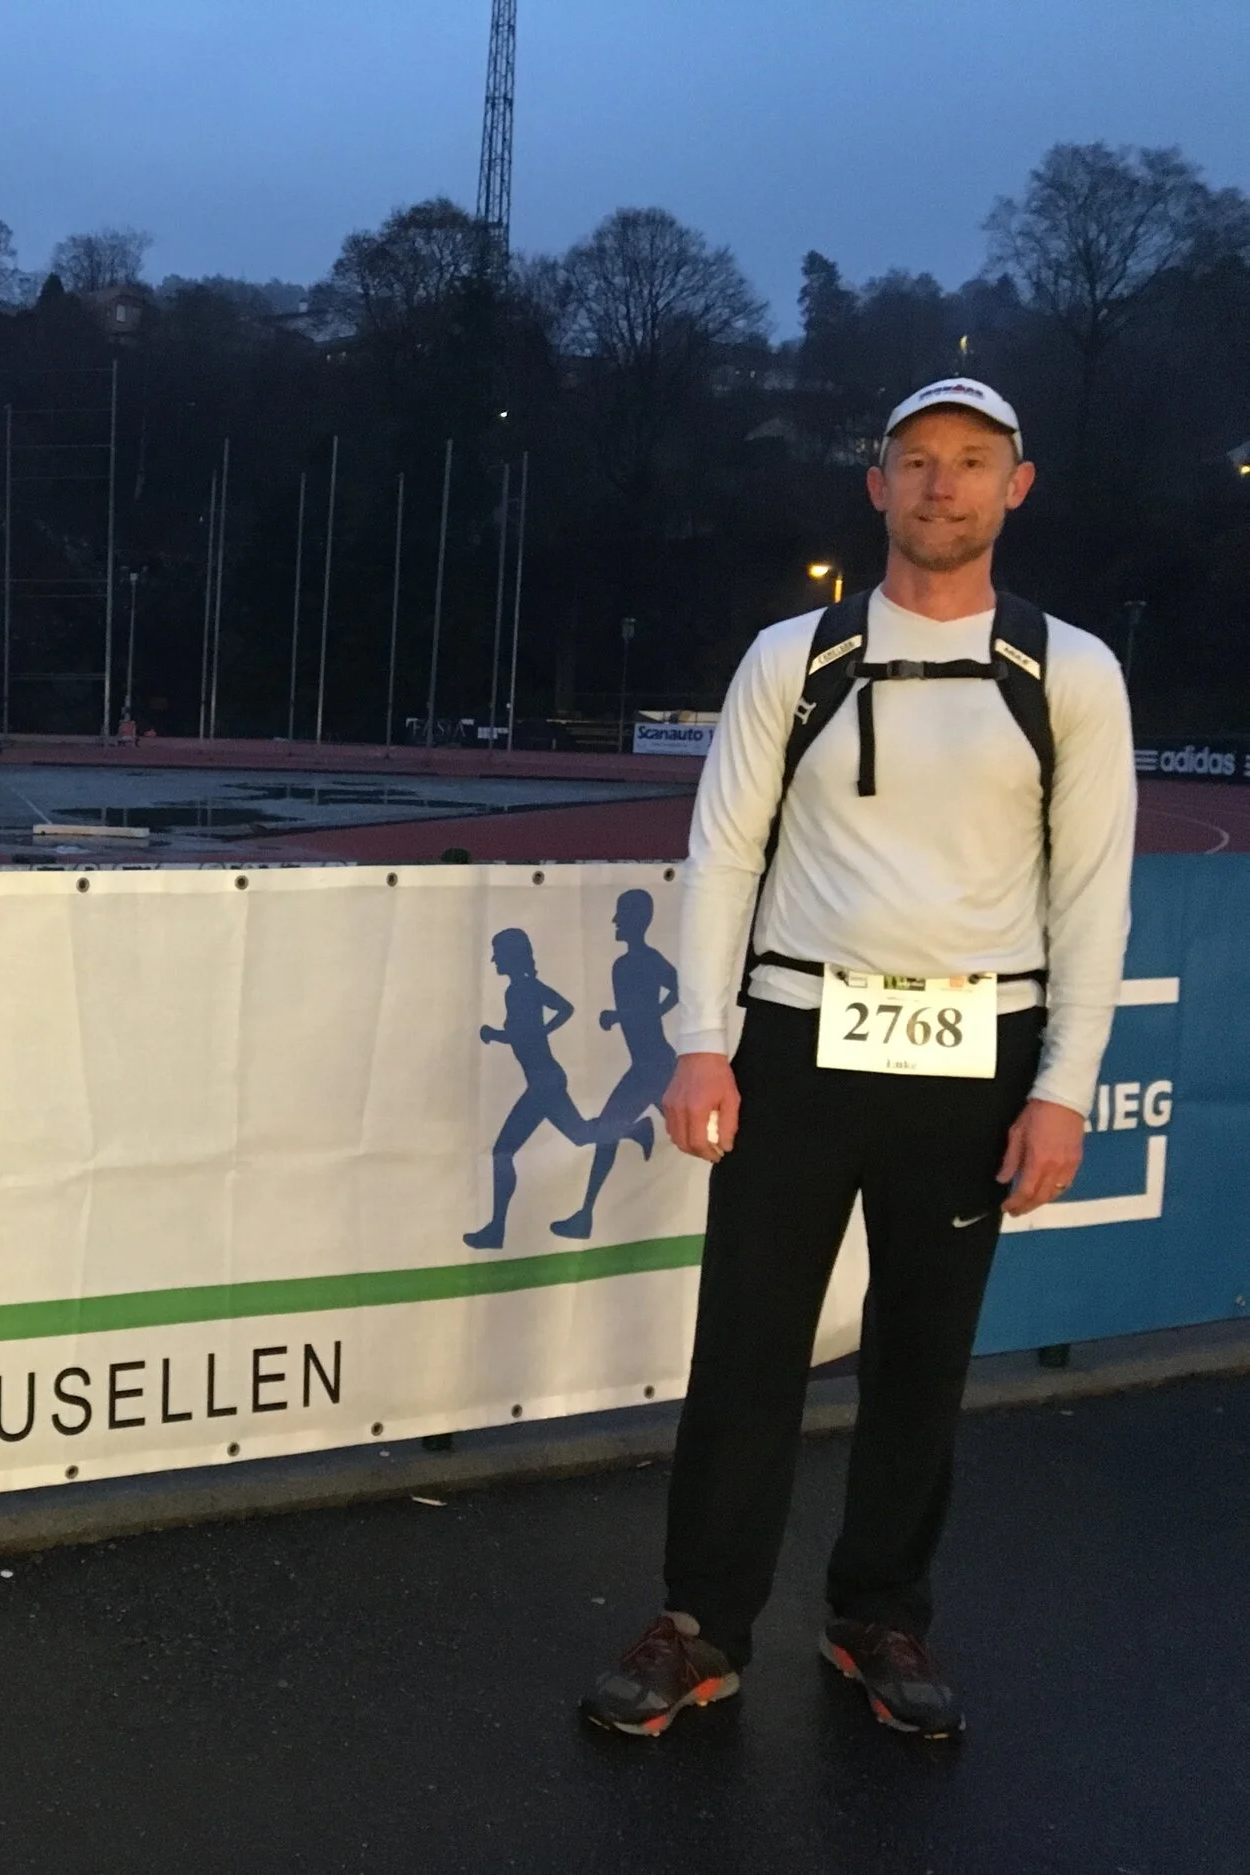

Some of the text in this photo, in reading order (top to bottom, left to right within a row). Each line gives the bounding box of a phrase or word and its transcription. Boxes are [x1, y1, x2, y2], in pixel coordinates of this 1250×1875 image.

[637, 725, 704, 741] Scanauto
[1160, 744, 1236, 776] adidas
[842, 1001, 963, 1048] 2768
[1083, 1080, 1174, 1133] IEG
